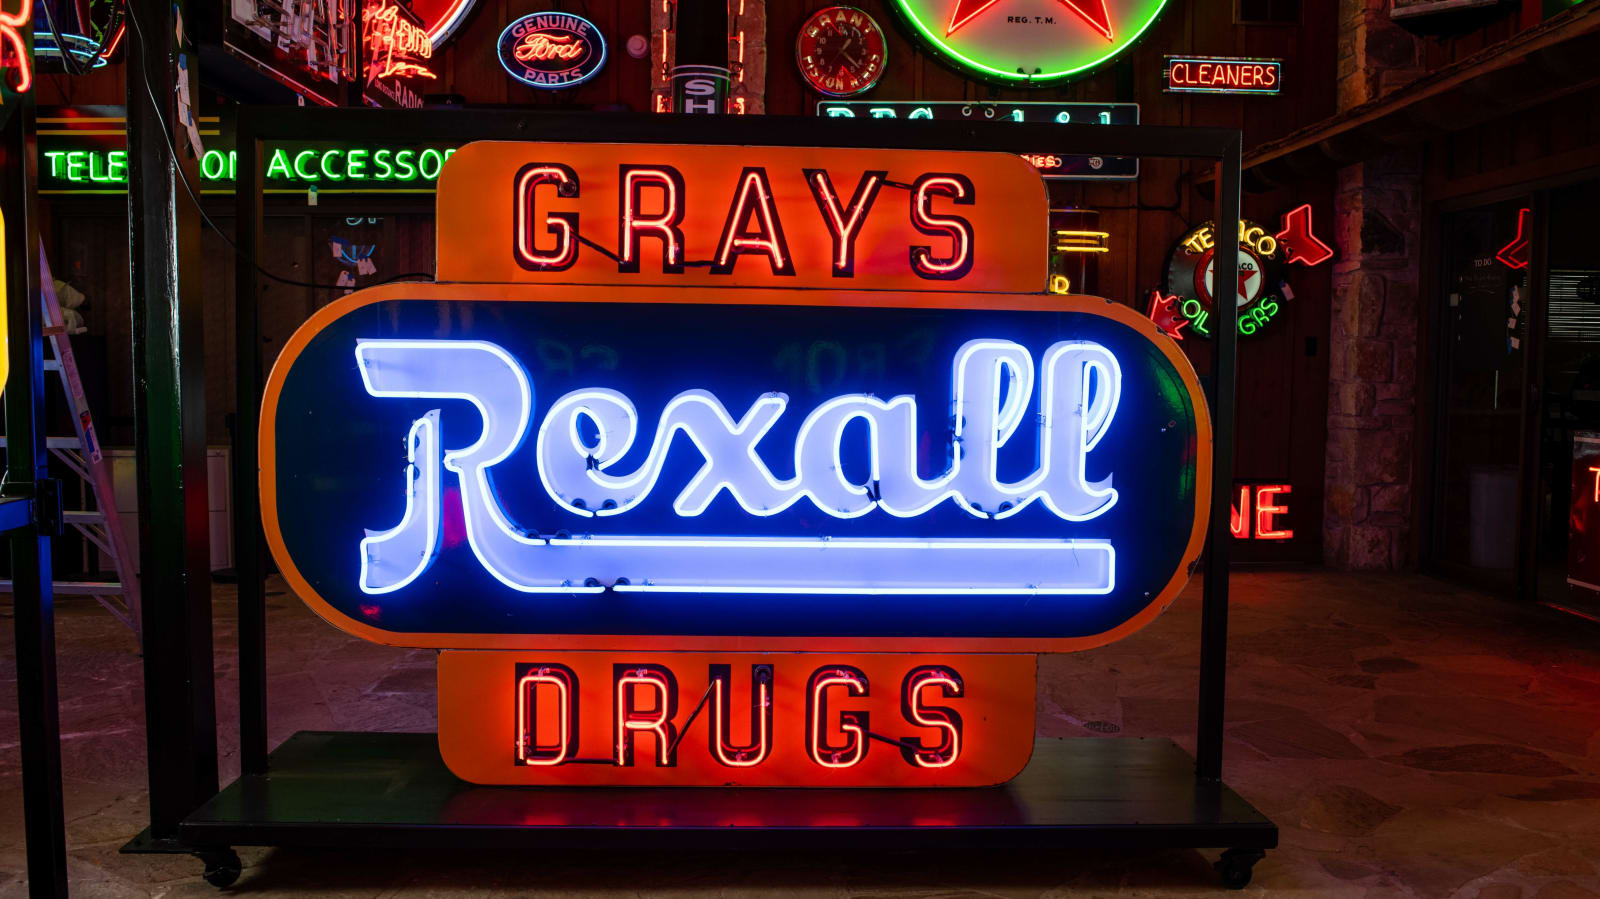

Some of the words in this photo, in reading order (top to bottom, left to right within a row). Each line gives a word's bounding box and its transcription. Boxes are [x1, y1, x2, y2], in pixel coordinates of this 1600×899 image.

[511, 15, 590, 37] GENUINE
[1007, 16, 1032, 24] REG.
[515, 33, 583, 60] Ford
[524, 68, 583, 84] PARTS
[1172, 63, 1276, 86] CLEANERS
[513, 162, 976, 281] GRAYS
[1181, 220, 1277, 256] TECO
[1181, 298, 1210, 335] OIL
[1237, 296, 1279, 335] GAS
[354, 337, 1123, 596] Rexall
[514, 662, 965, 768] DRUGS
